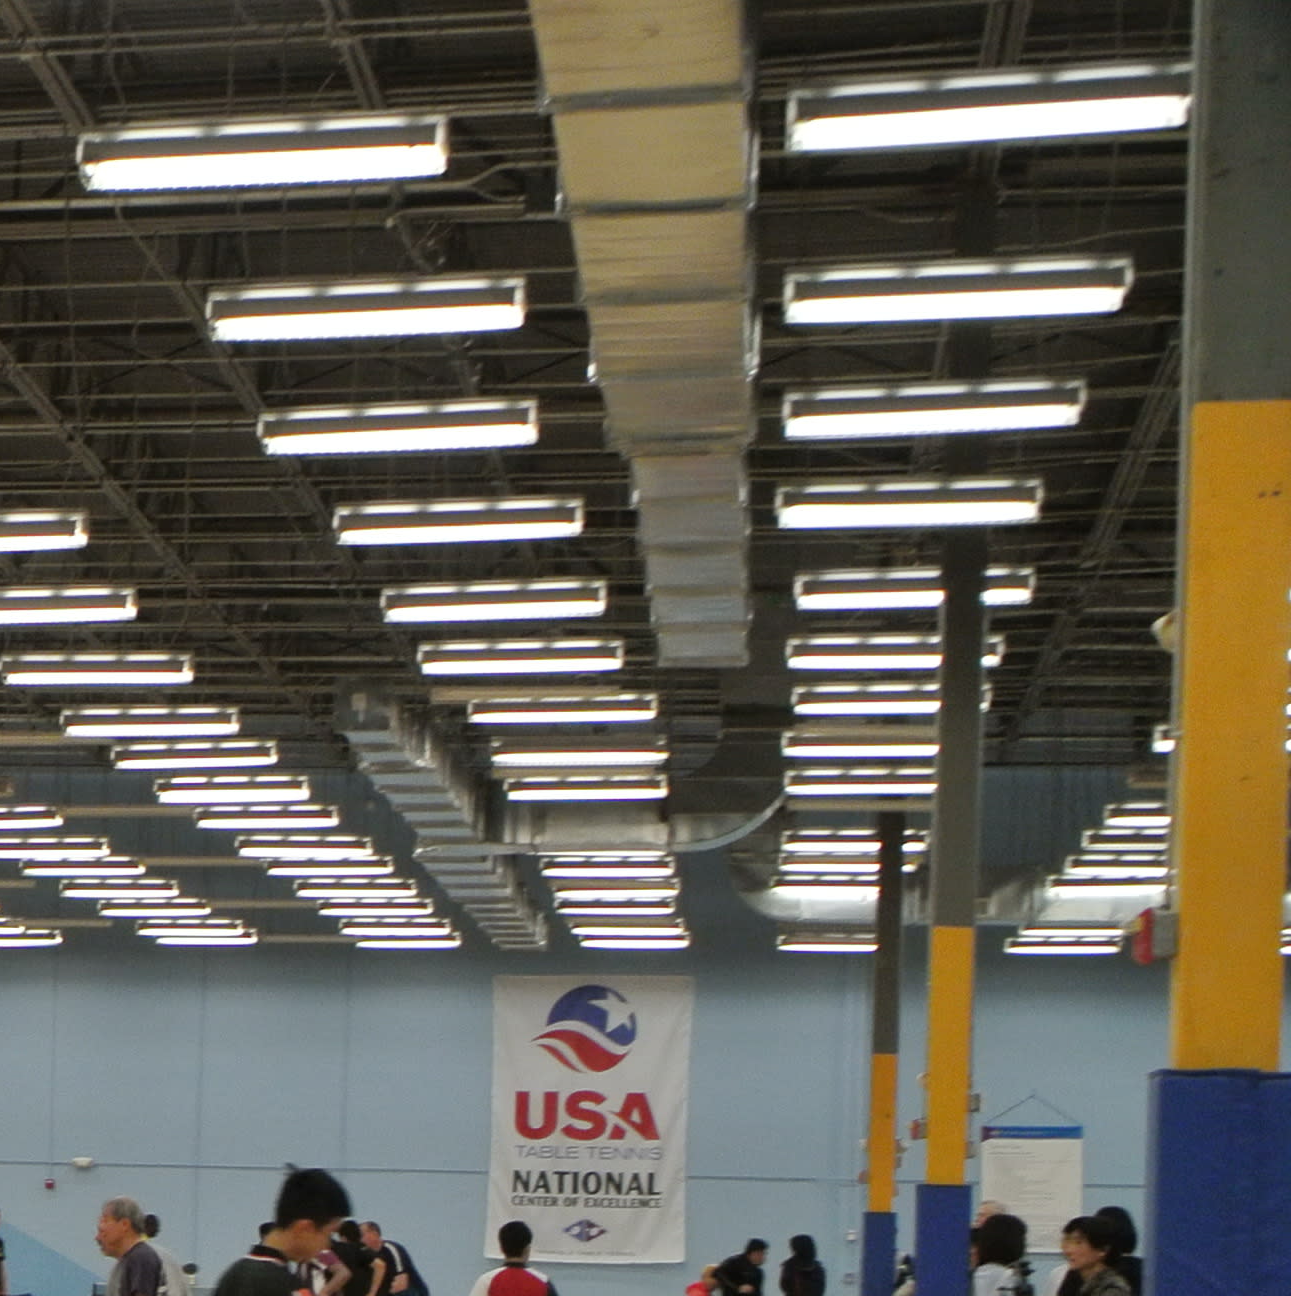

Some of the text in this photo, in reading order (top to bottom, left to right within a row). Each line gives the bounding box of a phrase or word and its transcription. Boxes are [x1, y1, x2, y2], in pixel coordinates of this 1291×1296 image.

[515, 1089, 660, 1141] USA
[514, 1145, 663, 1161] TABLE TENNIS
[512, 1169, 662, 1196] NATIONAL
[511, 1195, 663, 1209] CENTER OF EXCELLENCE
